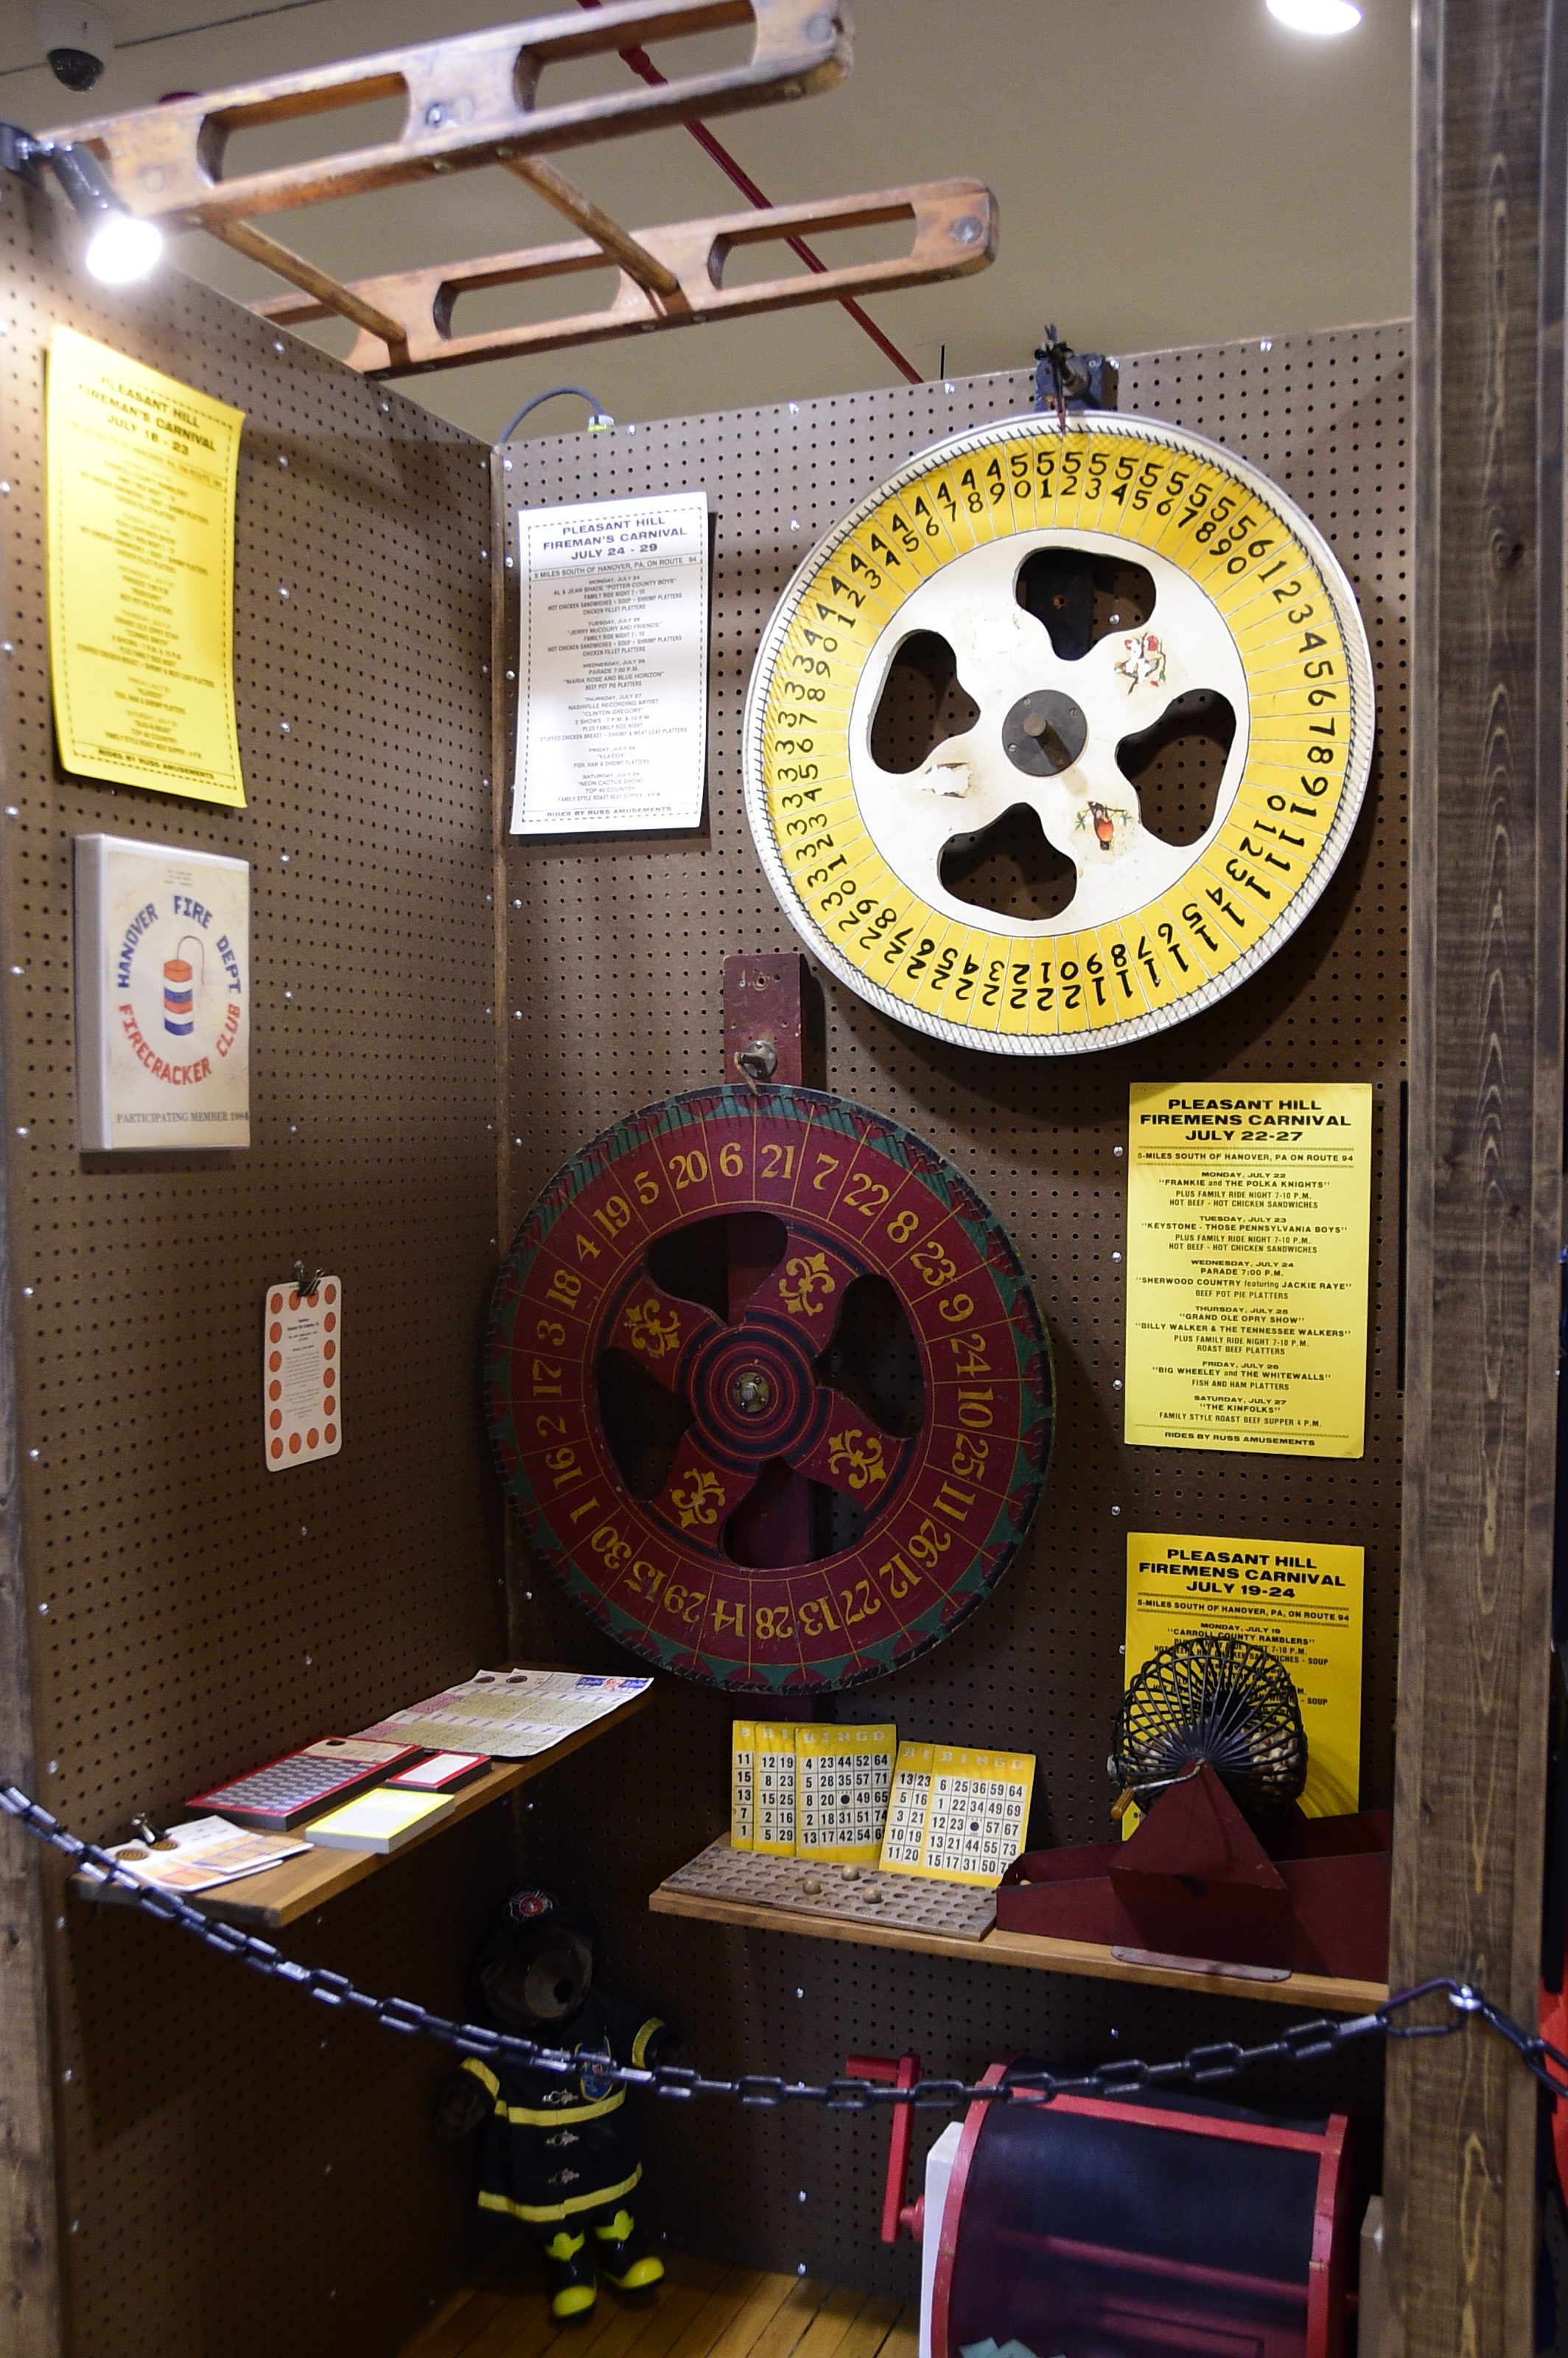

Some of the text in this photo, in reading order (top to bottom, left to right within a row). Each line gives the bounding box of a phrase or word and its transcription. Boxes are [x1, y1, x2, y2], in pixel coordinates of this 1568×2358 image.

[108, 415, 136, 433] JULY
[173, 408, 200, 429] HILL
[156, 418, 217, 452] CARNIVAL
[544, 528, 687, 550] FIREMAN'S CARNIVAL
[563, 517, 665, 535] PLEASANT HILL
[572, 544, 657, 560] JULY 24 29
[562, 568, 585, 576] SOUTH
[659, 558, 683, 566] ROUTE
[117, 895, 241, 993] HANOVER FIRE DEPT
[119, 1004, 241, 1085] FIRECRACKER CLUB
[117, 1111, 188, 1124] PARTICIPATING
[192, 1112, 231, 1123] MEMBER
[1169, 1099, 1322, 1110] PLEASANT HILL
[1141, 1114, 1351, 1126] FIREMENS CARNIVAL
[1186, 1130, 1303, 1141] JULY 22-27
[669, 1150, 708, 1189] 20
[720, 1143, 743, 1177] 6
[762, 1144, 794, 1178] 21
[813, 1153, 839, 1190] 7
[634, 1171, 659, 1204] 5
[844, 1173, 889, 1216] 22
[592, 1195, 631, 1239] 19
[886, 1211, 919, 1243] 8
[575, 1234, 601, 1262] 4
[910, 1242, 957, 1287] 23
[546, 1269, 582, 1310] 18
[1244, 1280, 1278, 1288] featuring
[951, 1333, 989, 1378] 24
[958, 1388, 994, 1428] 10
[1243, 1437, 1315, 1446] AMUSEMENTS
[545, 1448, 582, 1488] 16
[1167, 1549, 1317, 1568] PLEASANT HILL
[1139, 1562, 1345, 1586] FIREMENS CARNIVAL
[840, 1581, 881, 1624] 27
[1186, 1581, 1295, 1598] JULY 19-24
[710, 1600, 746, 1637] 14
[1138, 1599, 1172, 1608] 5-MILES
[1175, 1602, 1204, 1611] SOUTH
[1207, 1603, 1219, 1612] OF
[1222, 1605, 1269, 1617] HANOVER,
[1304, 1611, 1335, 1620] ROUTE
[1217, 1632, 1256, 1641] COUNTY
[805, 1754, 888, 1770] 4 23 44 52 64
[939, 1780, 1023, 1797] 6 25 36 59 64
